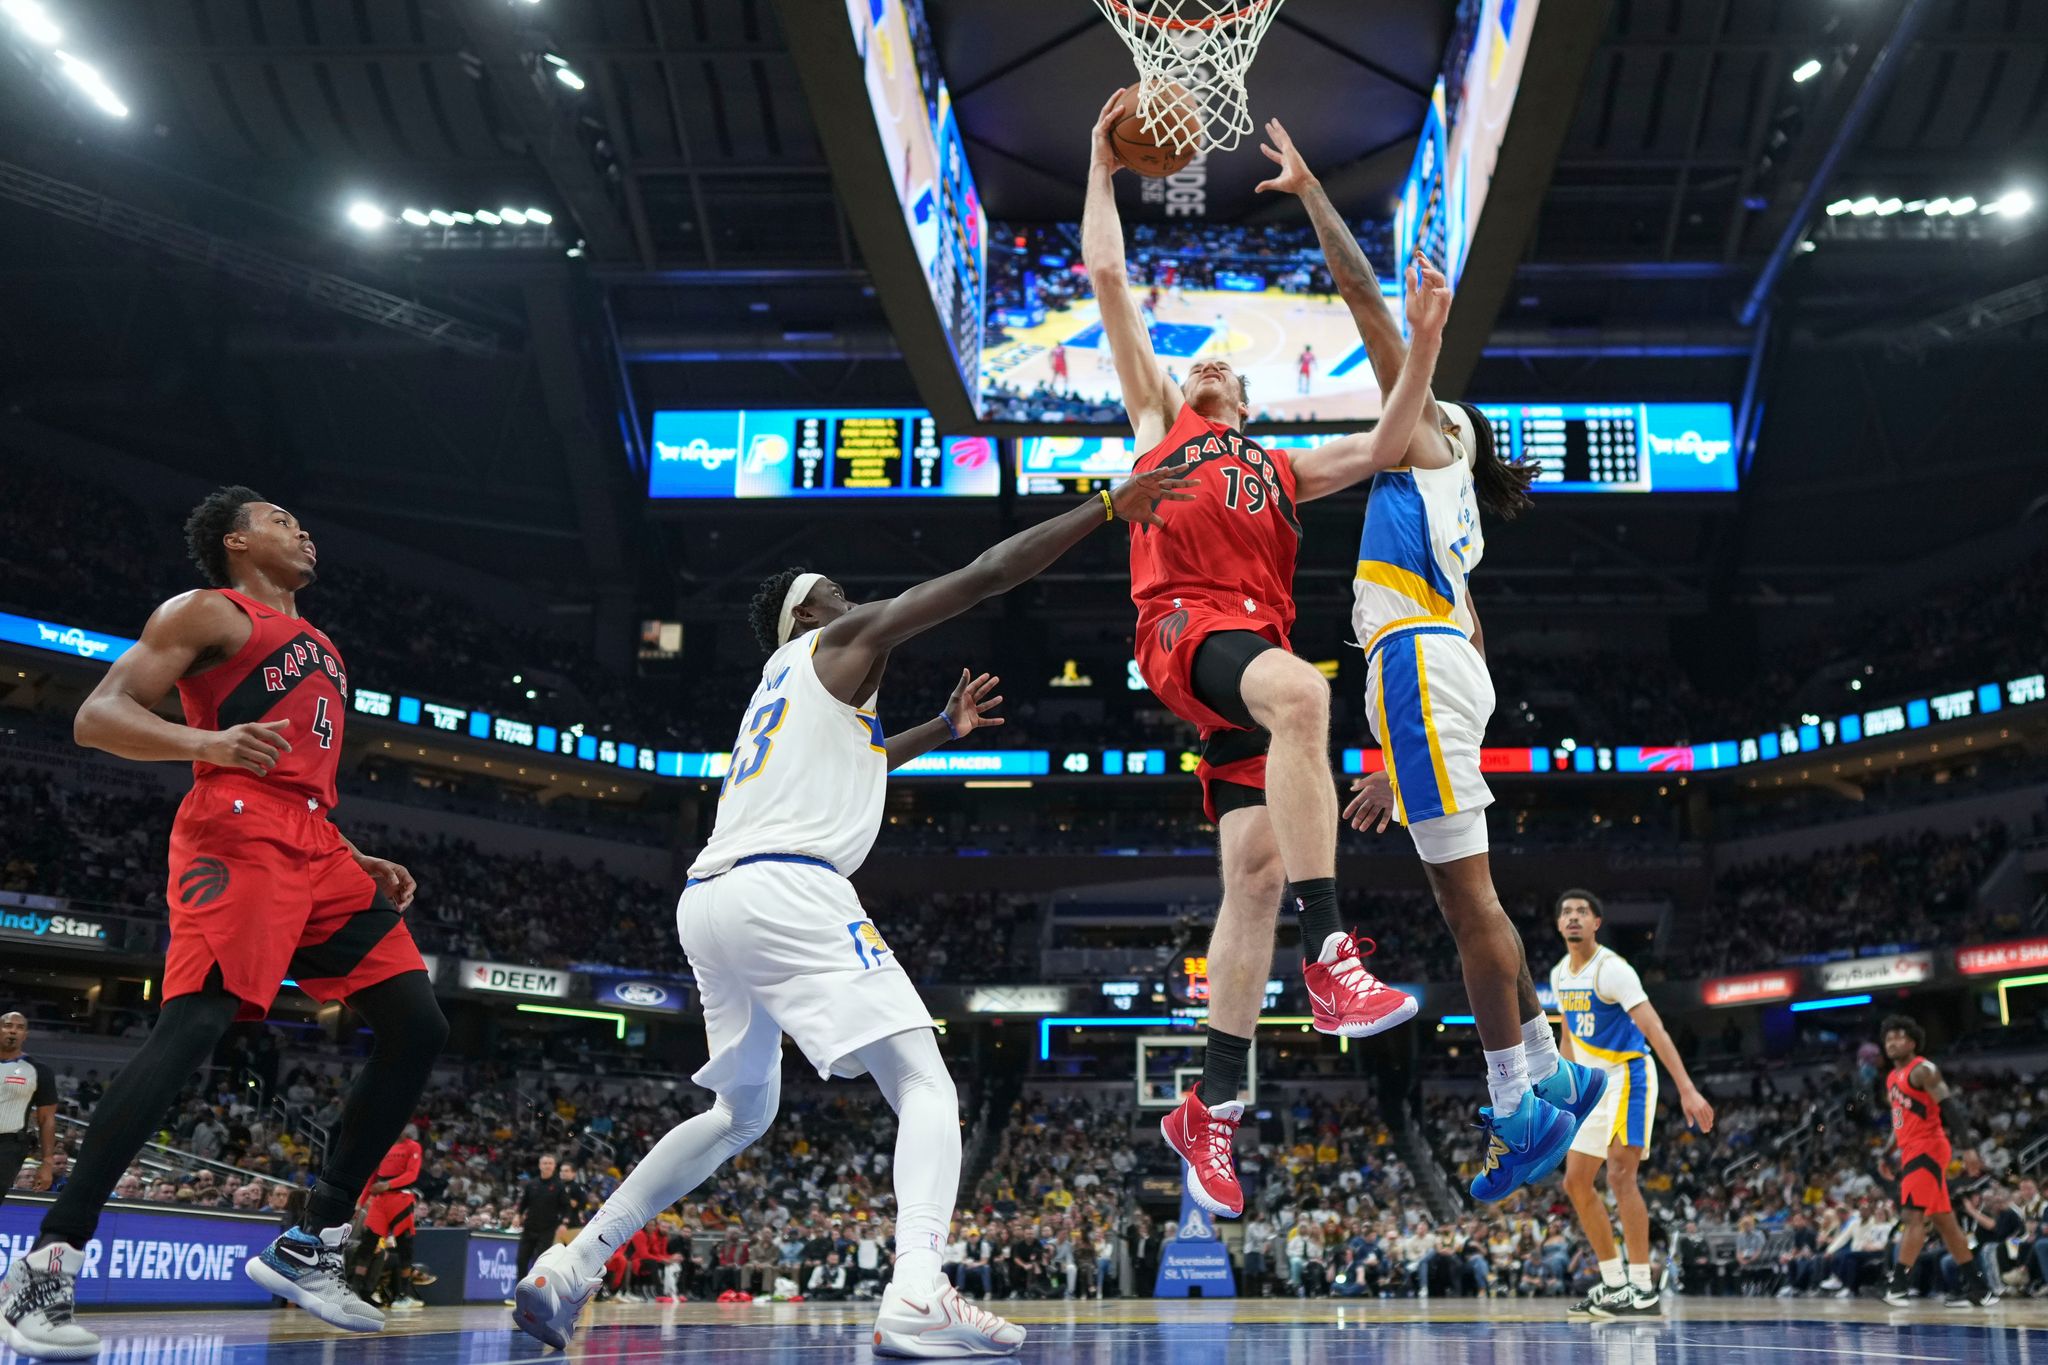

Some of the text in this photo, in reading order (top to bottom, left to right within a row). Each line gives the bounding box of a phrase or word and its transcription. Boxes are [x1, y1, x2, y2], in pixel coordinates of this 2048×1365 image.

[1219, 466, 1267, 515] 19
[311, 696, 332, 749] 4
[1063, 753, 1089, 773] 43
[491, 970, 557, 992] DEEM
[1575, 1012, 1596, 1037] 26
